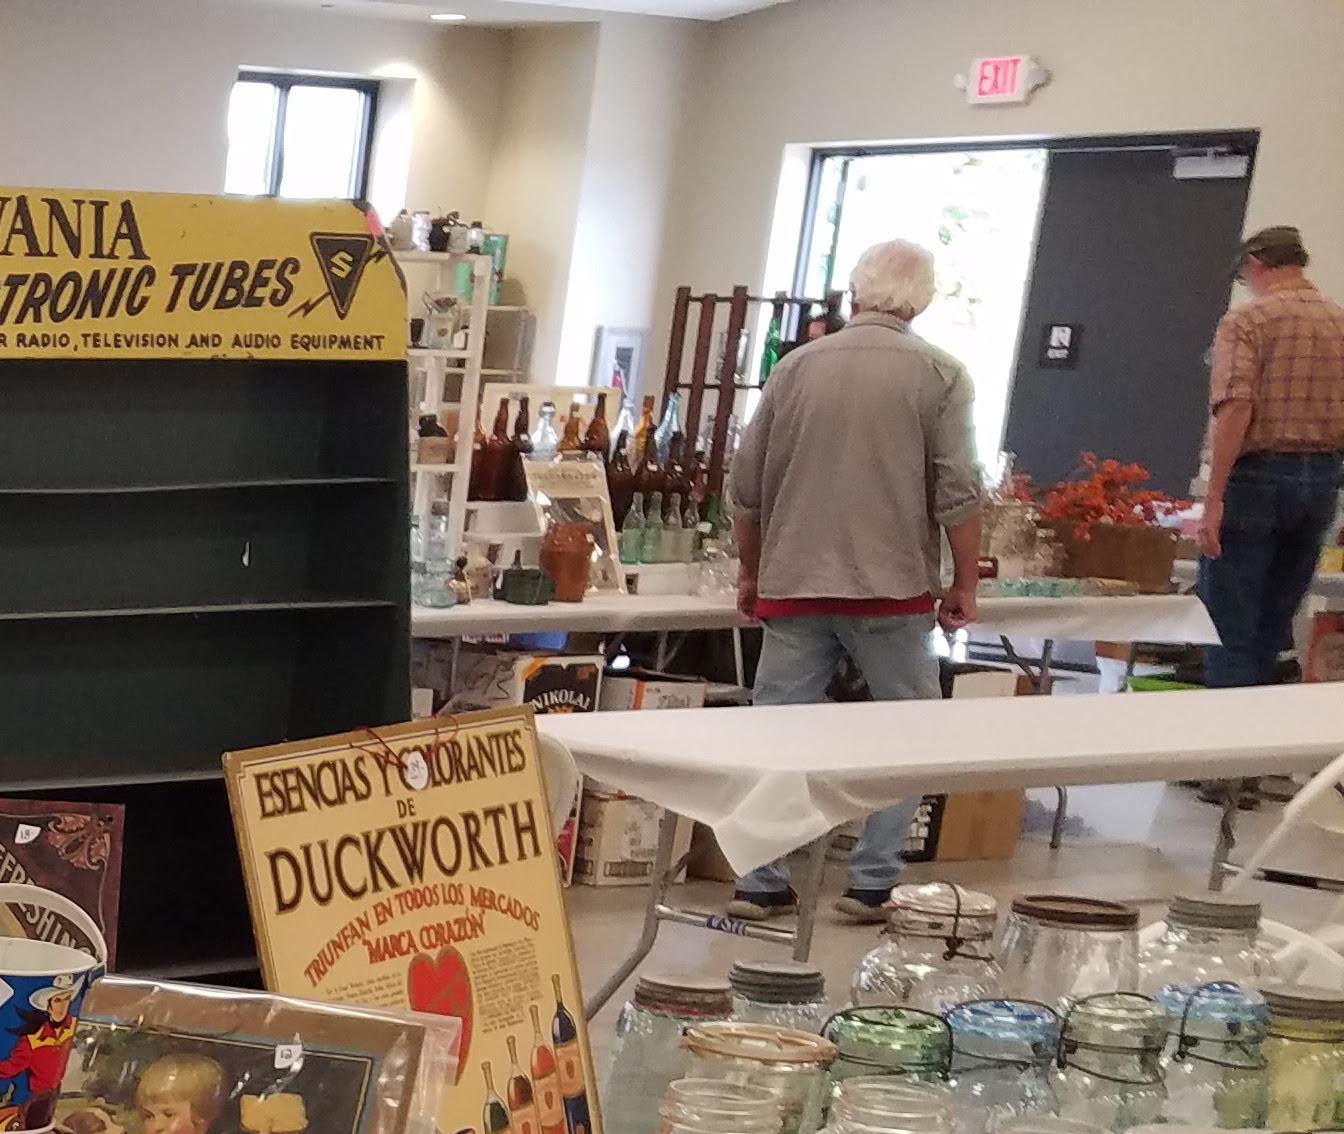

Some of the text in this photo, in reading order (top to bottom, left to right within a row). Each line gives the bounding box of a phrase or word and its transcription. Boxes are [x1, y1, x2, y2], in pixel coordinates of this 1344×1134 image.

[978, 56, 1022, 97] EXIT
[166, 256, 301, 314] TUBES
[81, 332, 179, 350] TELEVISION
[186, 333, 222, 349] AND
[231, 334, 282, 350] AUDIO
[290, 333, 385, 352] EQUIPMENT
[531, 688, 592, 711] NIKOLAI
[253, 729, 527, 820] ESENCIAS Y CLORANTES
[396, 798, 417, 820] DE
[263, 798, 543, 916] DUCKWORTH
[304, 883, 541, 988] TRIUNFAN EN TODOS LOS MERCADOS
